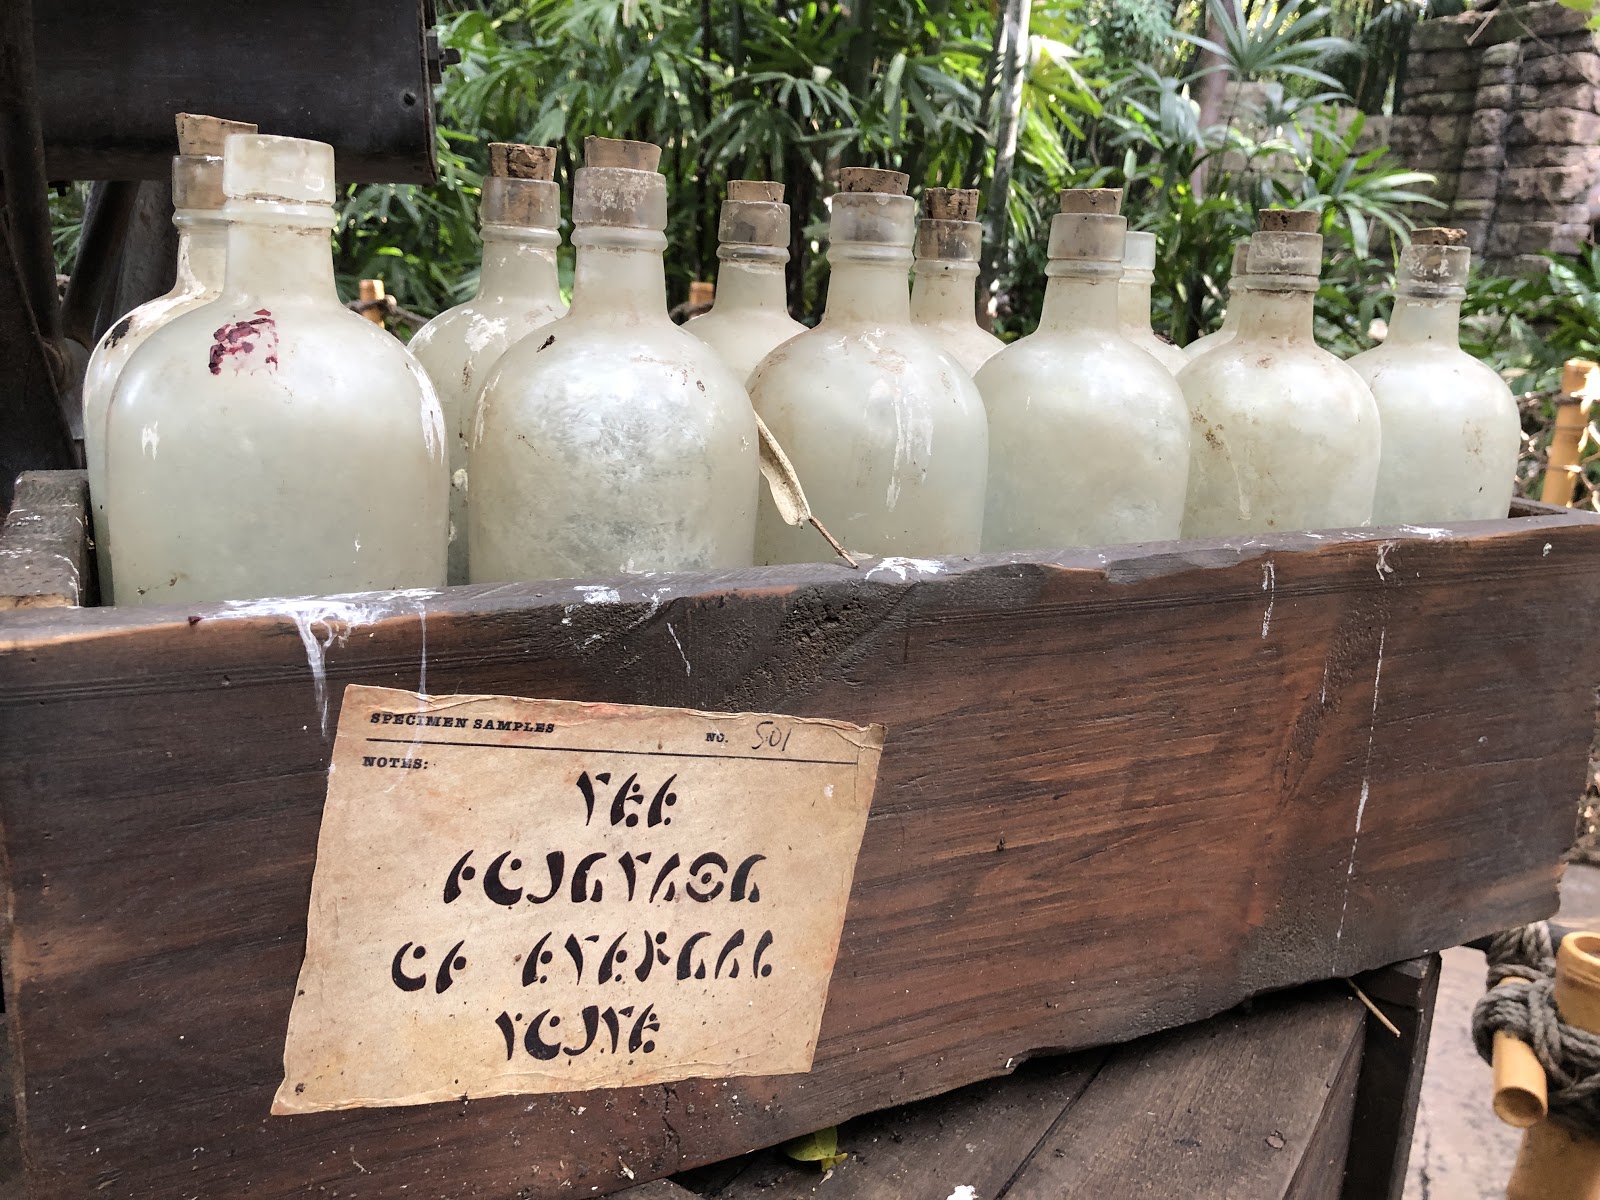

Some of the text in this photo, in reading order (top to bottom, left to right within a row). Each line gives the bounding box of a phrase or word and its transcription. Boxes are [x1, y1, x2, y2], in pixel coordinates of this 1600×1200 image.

[370, 712, 556, 734] SPECIMEN SAMPLES
[705, 732, 729, 743] NO.
[362, 756, 429, 770] NOTES:
